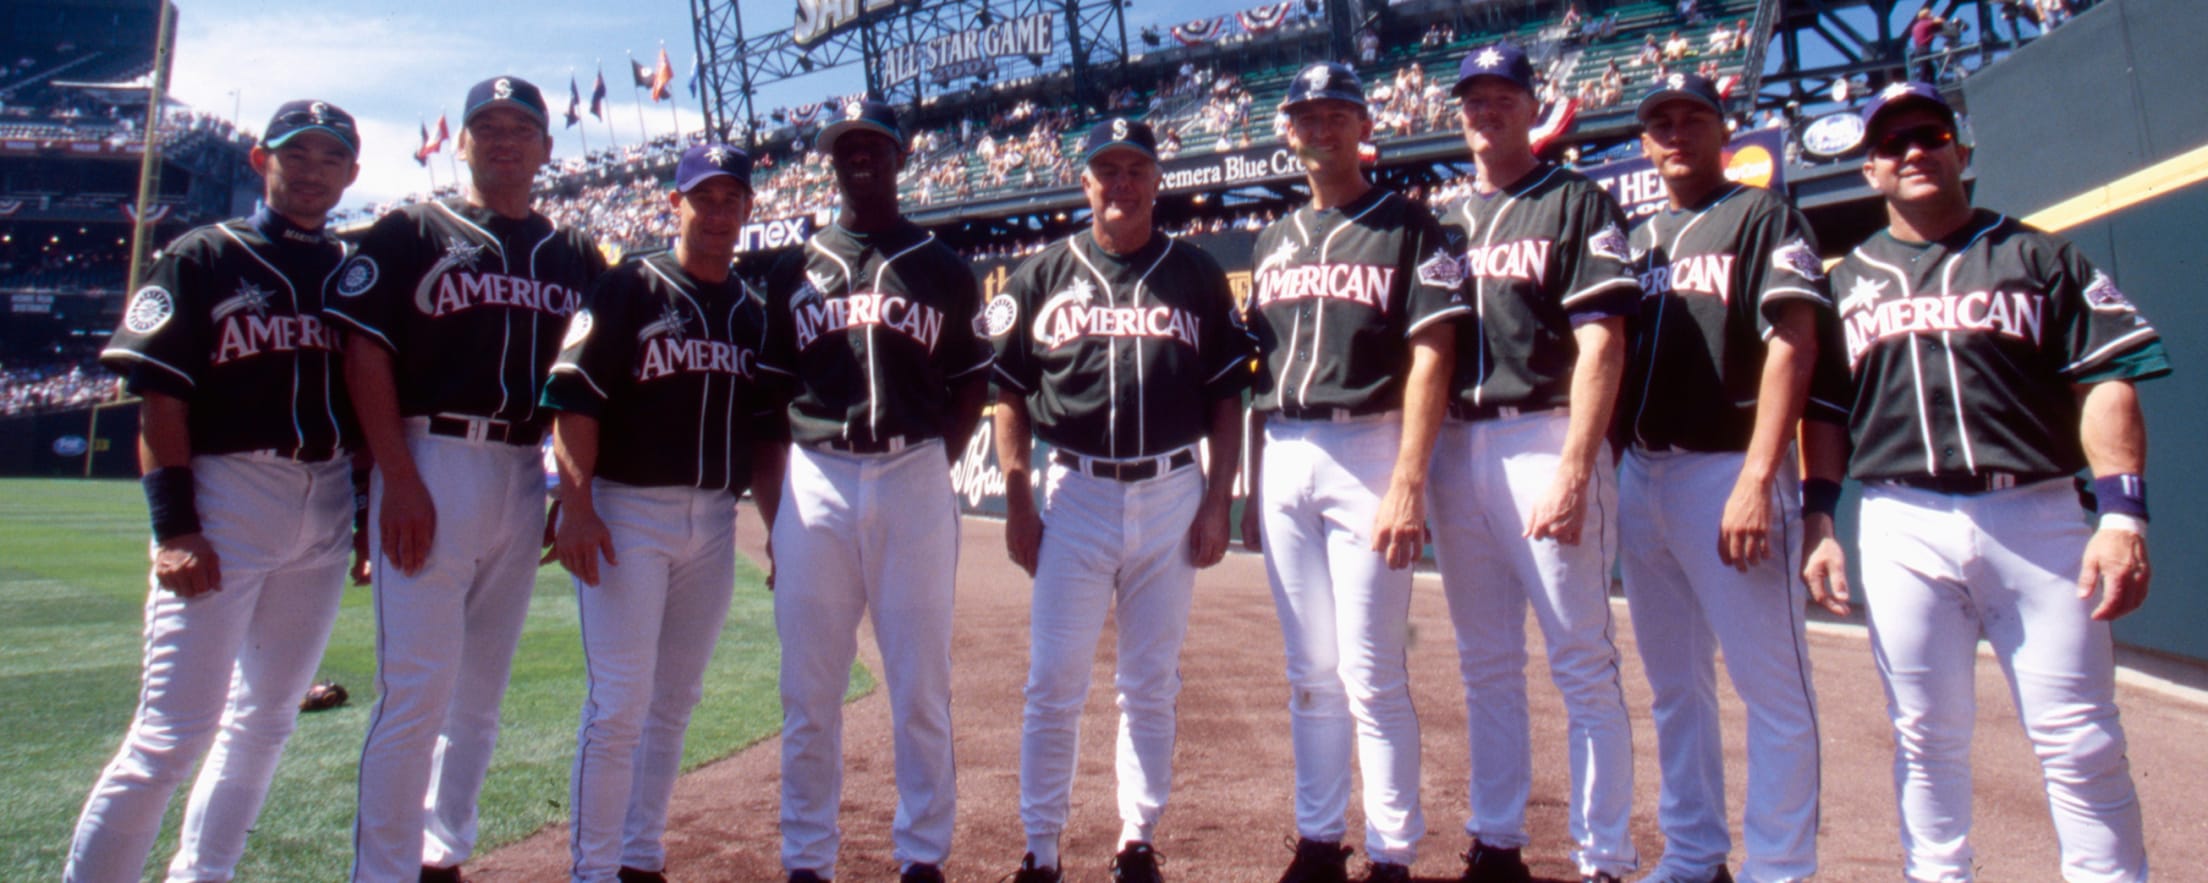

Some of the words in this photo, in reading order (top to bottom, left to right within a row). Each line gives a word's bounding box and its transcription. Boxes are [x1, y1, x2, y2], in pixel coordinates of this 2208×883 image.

[884, 45, 919, 89] ALL
[926, 29, 979, 70] STAR
[984, 12, 1052, 57] GAME
[494, 78, 513, 99] S
[1112, 117, 1129, 141] S
[1224, 154, 1268, 182] Blue
[431, 271, 582, 320] AMERICA
[1257, 262, 1396, 314] AMERICAN
[793, 292, 944, 356] AMERICAN
[1049, 305, 1201, 354] AMERICAN
[1844, 290, 2044, 368] AMERICAN
